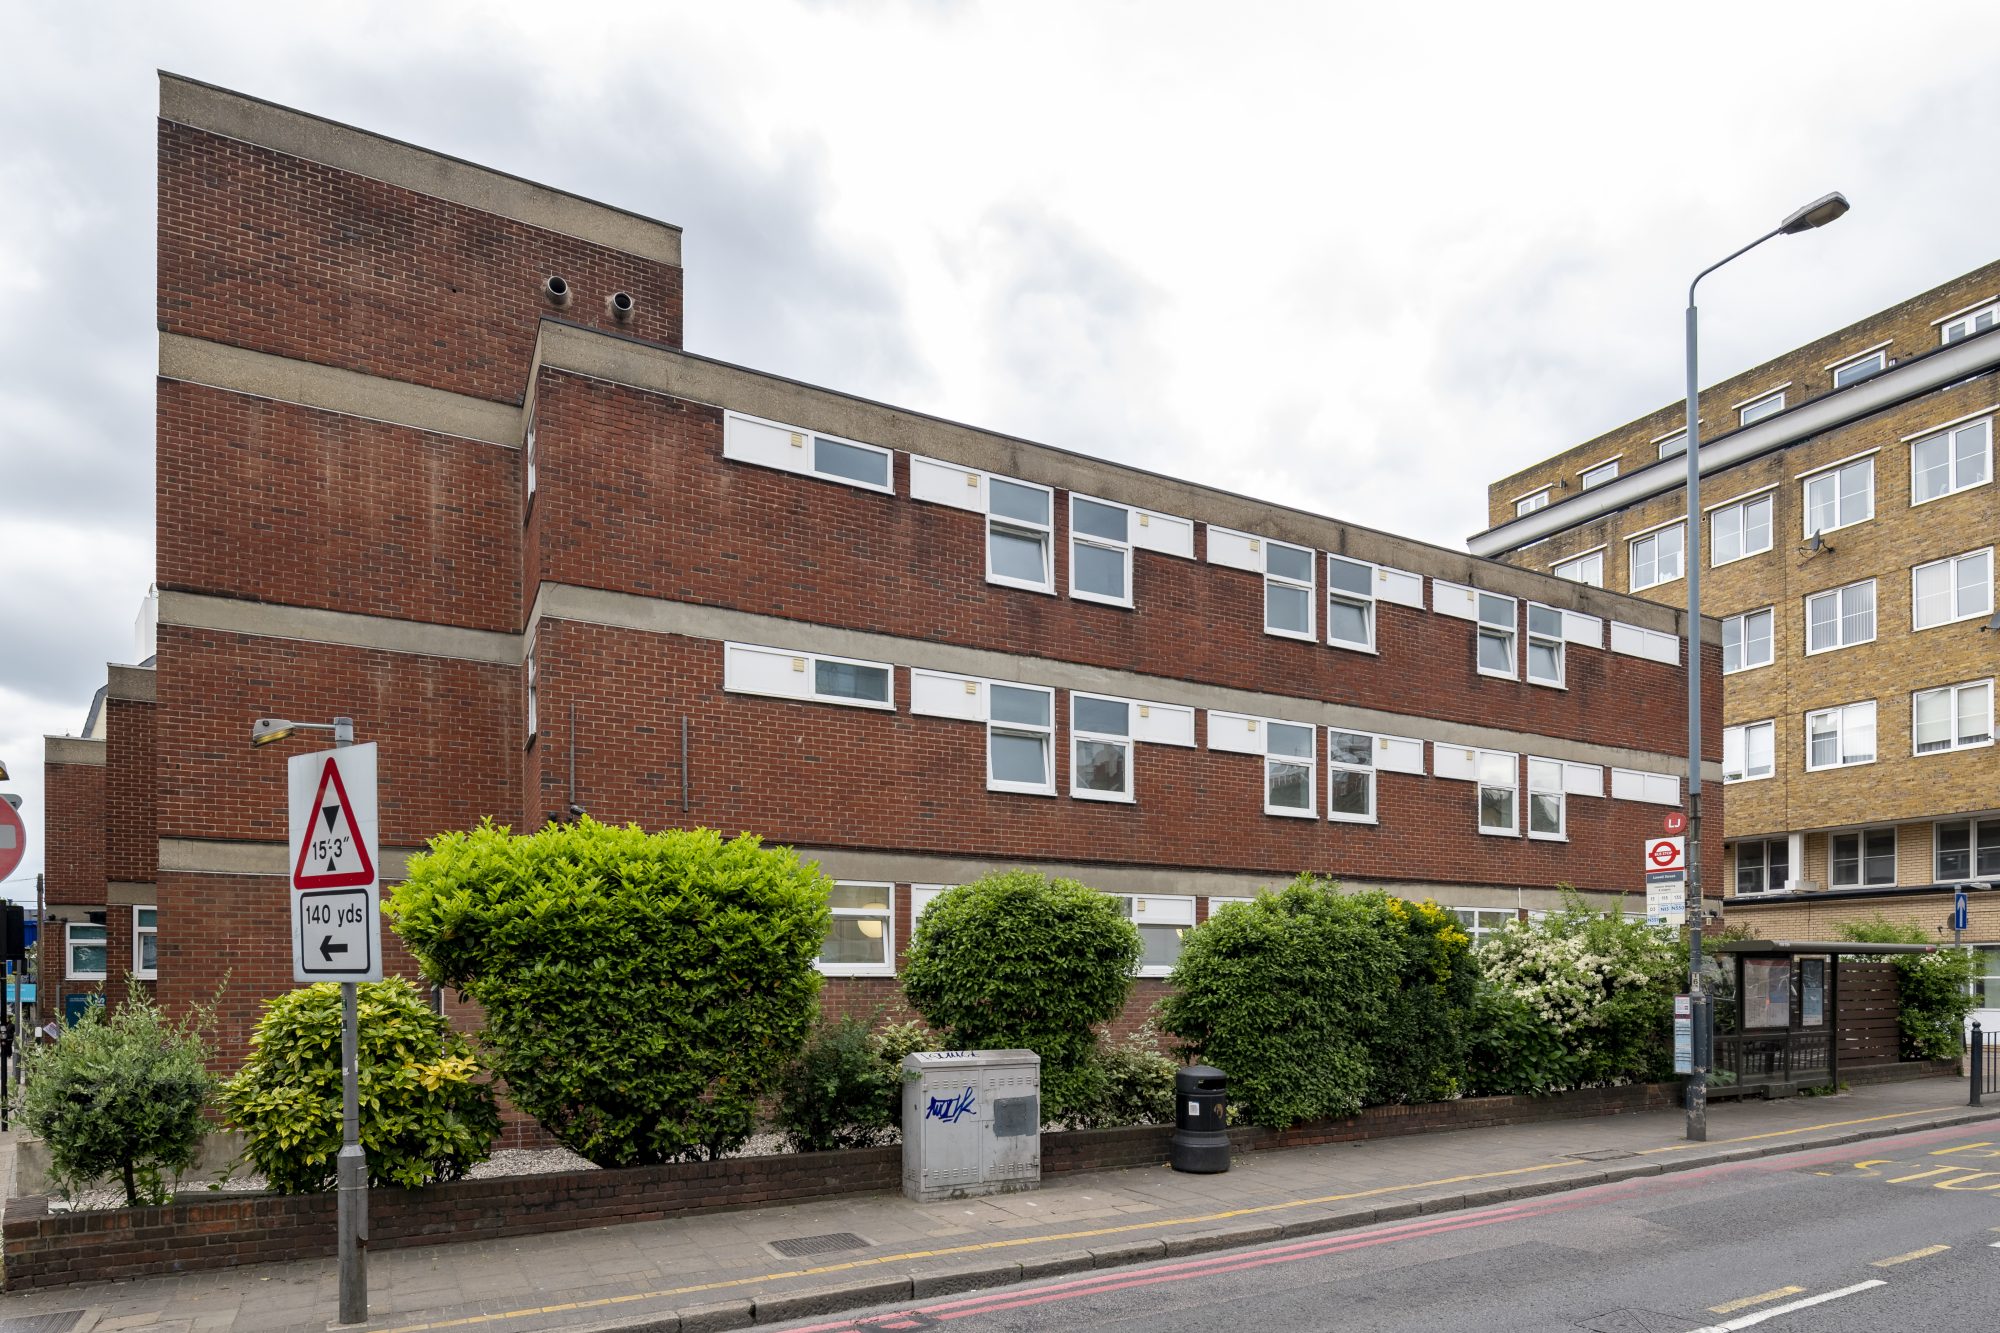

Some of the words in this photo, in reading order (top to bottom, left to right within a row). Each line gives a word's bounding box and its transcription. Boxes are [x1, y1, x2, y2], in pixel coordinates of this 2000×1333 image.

[1668, 818, 1681, 828] LJ
[306, 904, 331, 925] 140
[337, 903, 363, 928] yds
